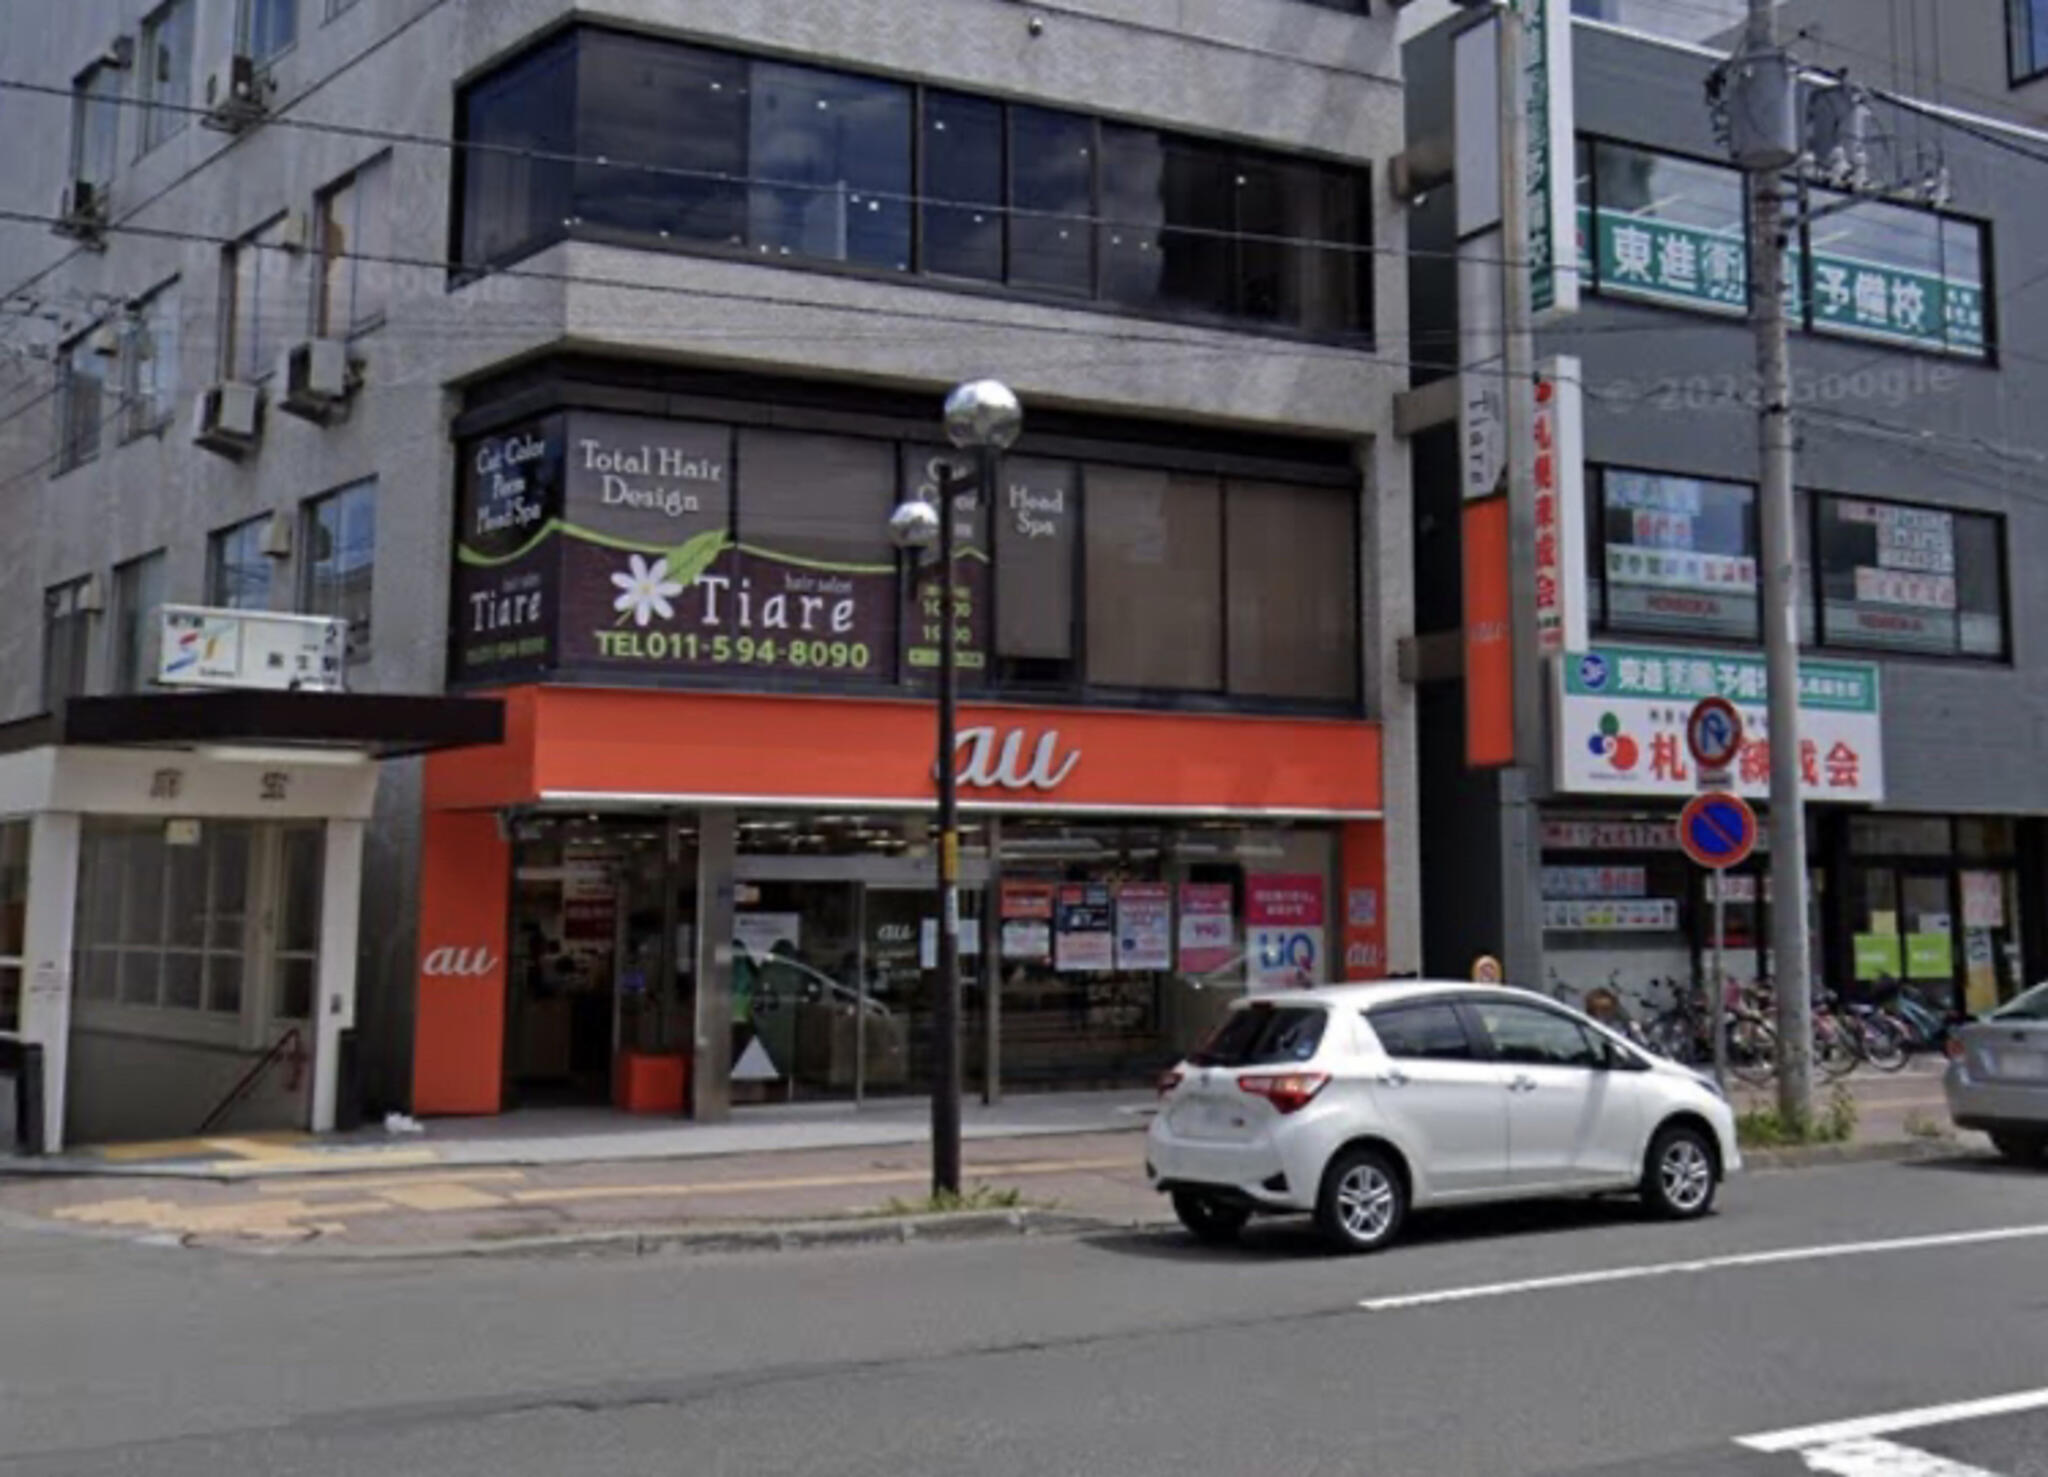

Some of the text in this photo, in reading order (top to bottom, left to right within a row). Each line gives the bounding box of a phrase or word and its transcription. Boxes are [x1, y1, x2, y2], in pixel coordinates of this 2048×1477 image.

[505, 434, 545, 465] Color
[580, 438, 721, 481] Total Hair
[602, 474, 699, 517] Design
[1009, 486, 1064, 513] Head
[1017, 511, 1055, 539] Spa
[470, 592, 542, 632] Tiare
[693, 575, 855, 632] Tiare
[931, 725, 1083, 788] au
[877, 923, 913, 940] au
[421, 944, 499, 977] au
[1259, 932, 1316, 971] UQ
